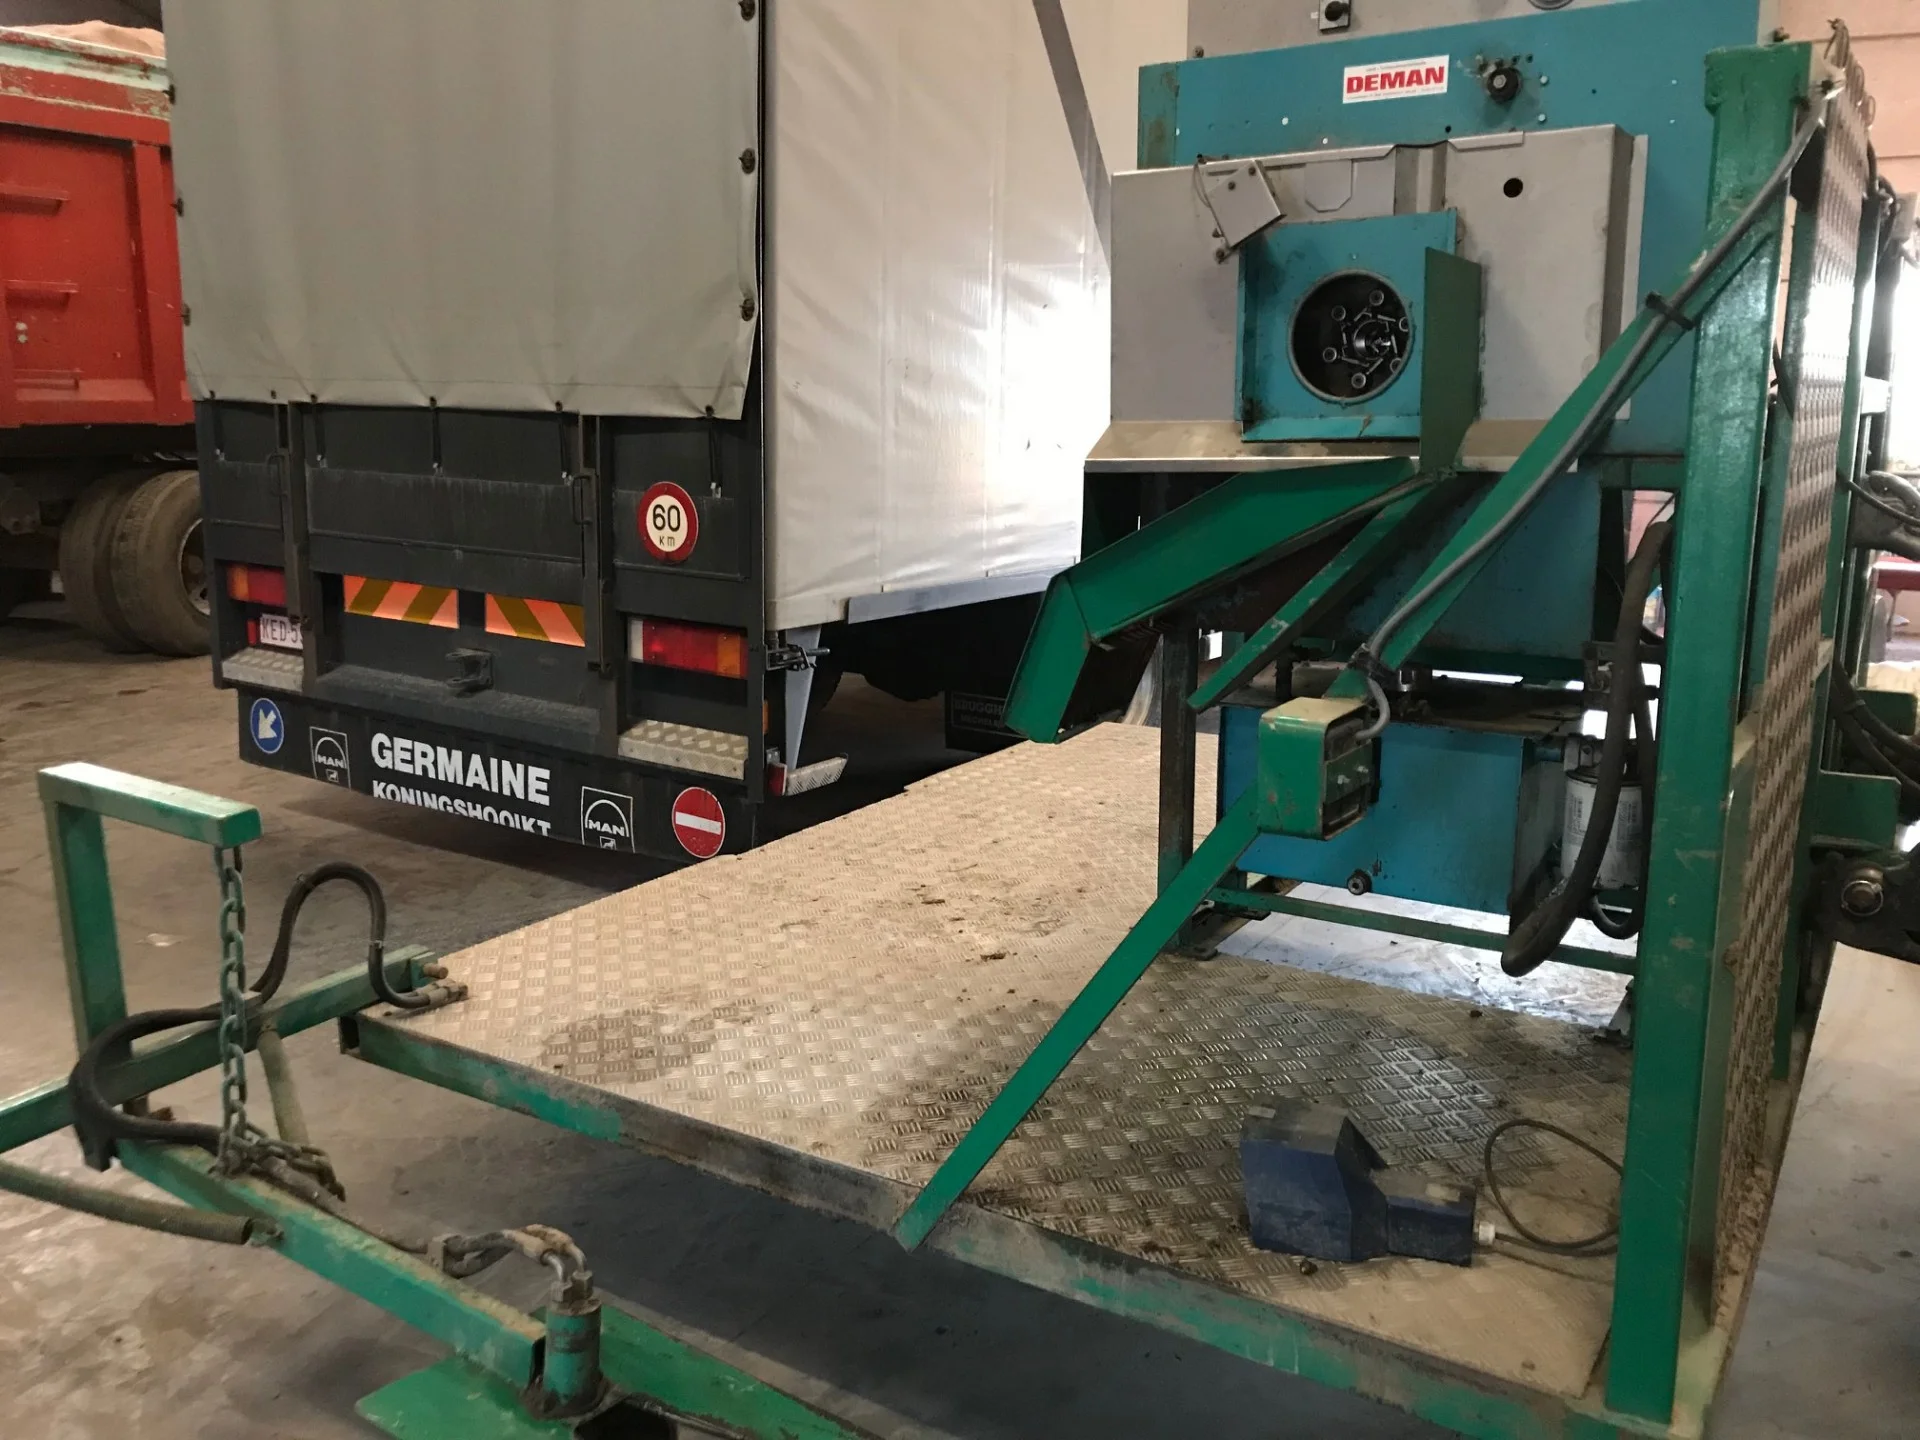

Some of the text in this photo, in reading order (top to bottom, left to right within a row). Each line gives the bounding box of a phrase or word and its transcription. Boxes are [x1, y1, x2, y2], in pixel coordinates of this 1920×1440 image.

[1346, 64, 1445, 94] DEMAN
[652, 504, 681, 532] 60
[262, 618, 303, 644] KED-5
[317, 753, 345, 769] MAN
[371, 732, 551, 806] GERMAINE
[588, 819, 626, 838] MAN
